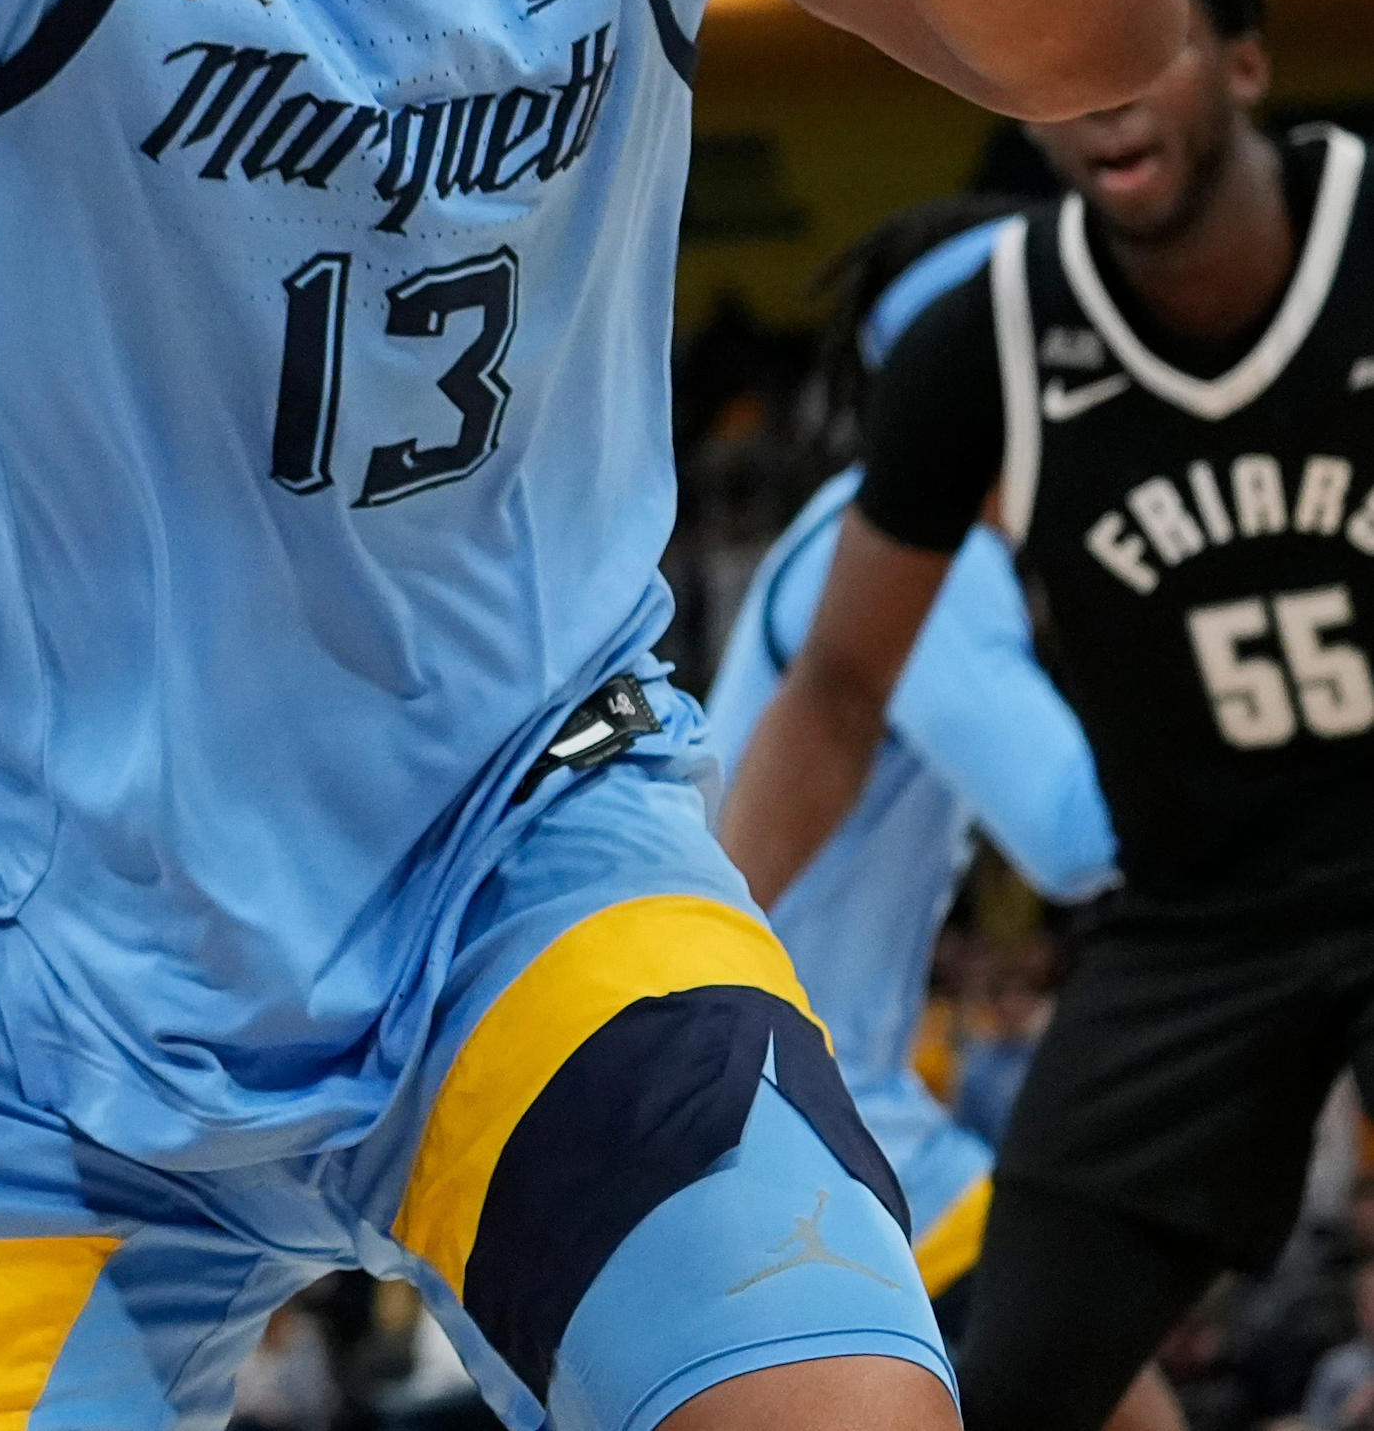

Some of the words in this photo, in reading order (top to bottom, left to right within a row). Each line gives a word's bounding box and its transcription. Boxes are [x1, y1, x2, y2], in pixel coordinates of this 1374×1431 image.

[141, 22, 617, 236] Marquett
[270, 244, 518, 509] 13
[1187, 584, 1374, 751] 55
